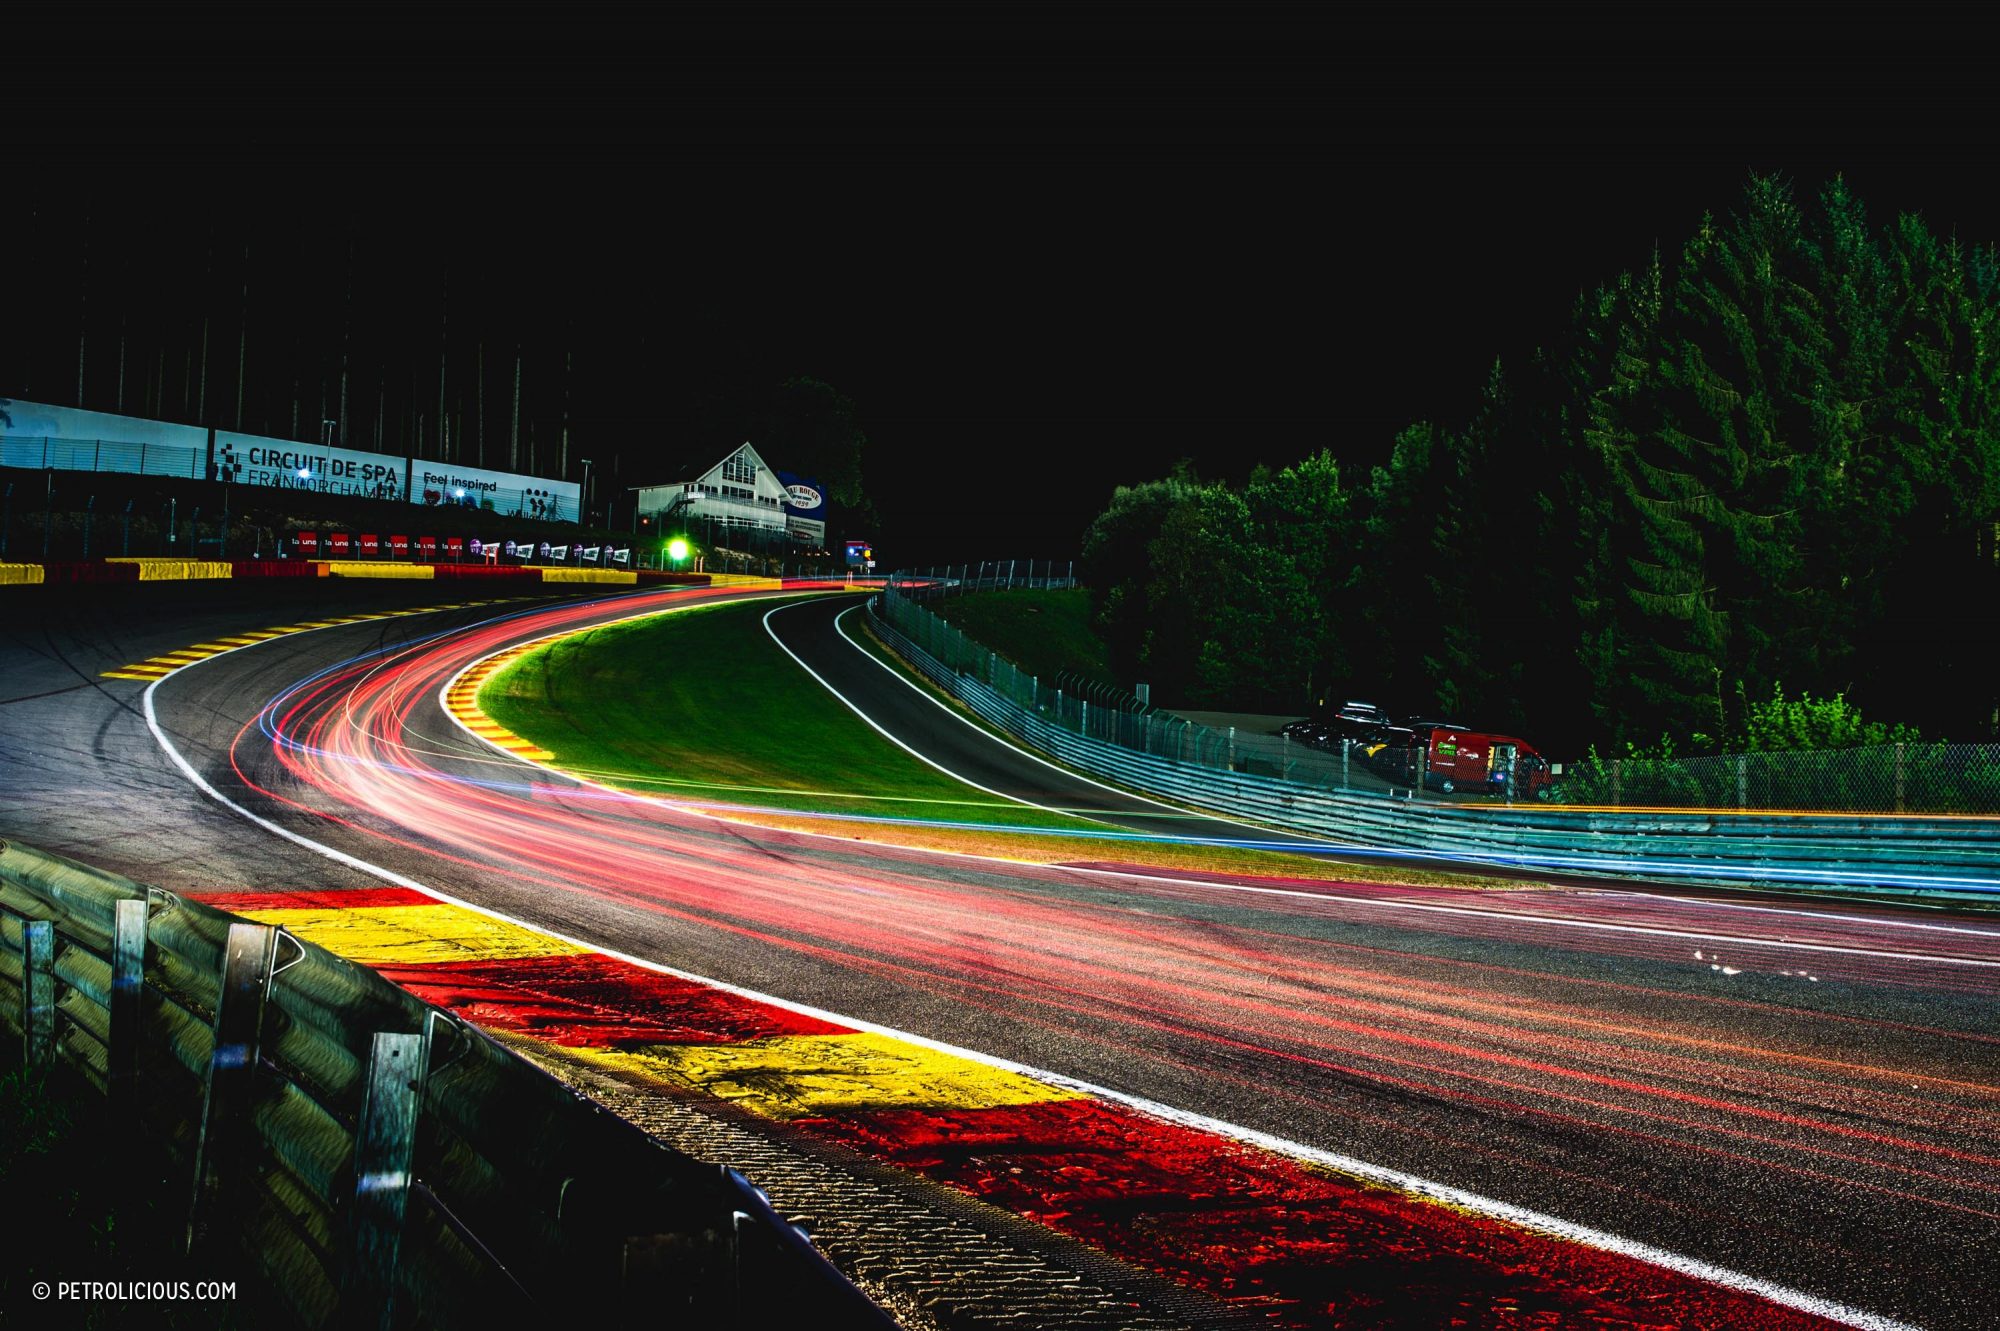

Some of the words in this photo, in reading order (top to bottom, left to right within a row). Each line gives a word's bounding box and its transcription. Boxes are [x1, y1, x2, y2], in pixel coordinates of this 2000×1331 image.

[250, 447, 326, 473] CIRCUIT
[332, 459, 356, 479] DE
[361, 463, 397, 484] SPA
[423, 472, 447, 484] Feel
[451, 475, 496, 492] inspired
